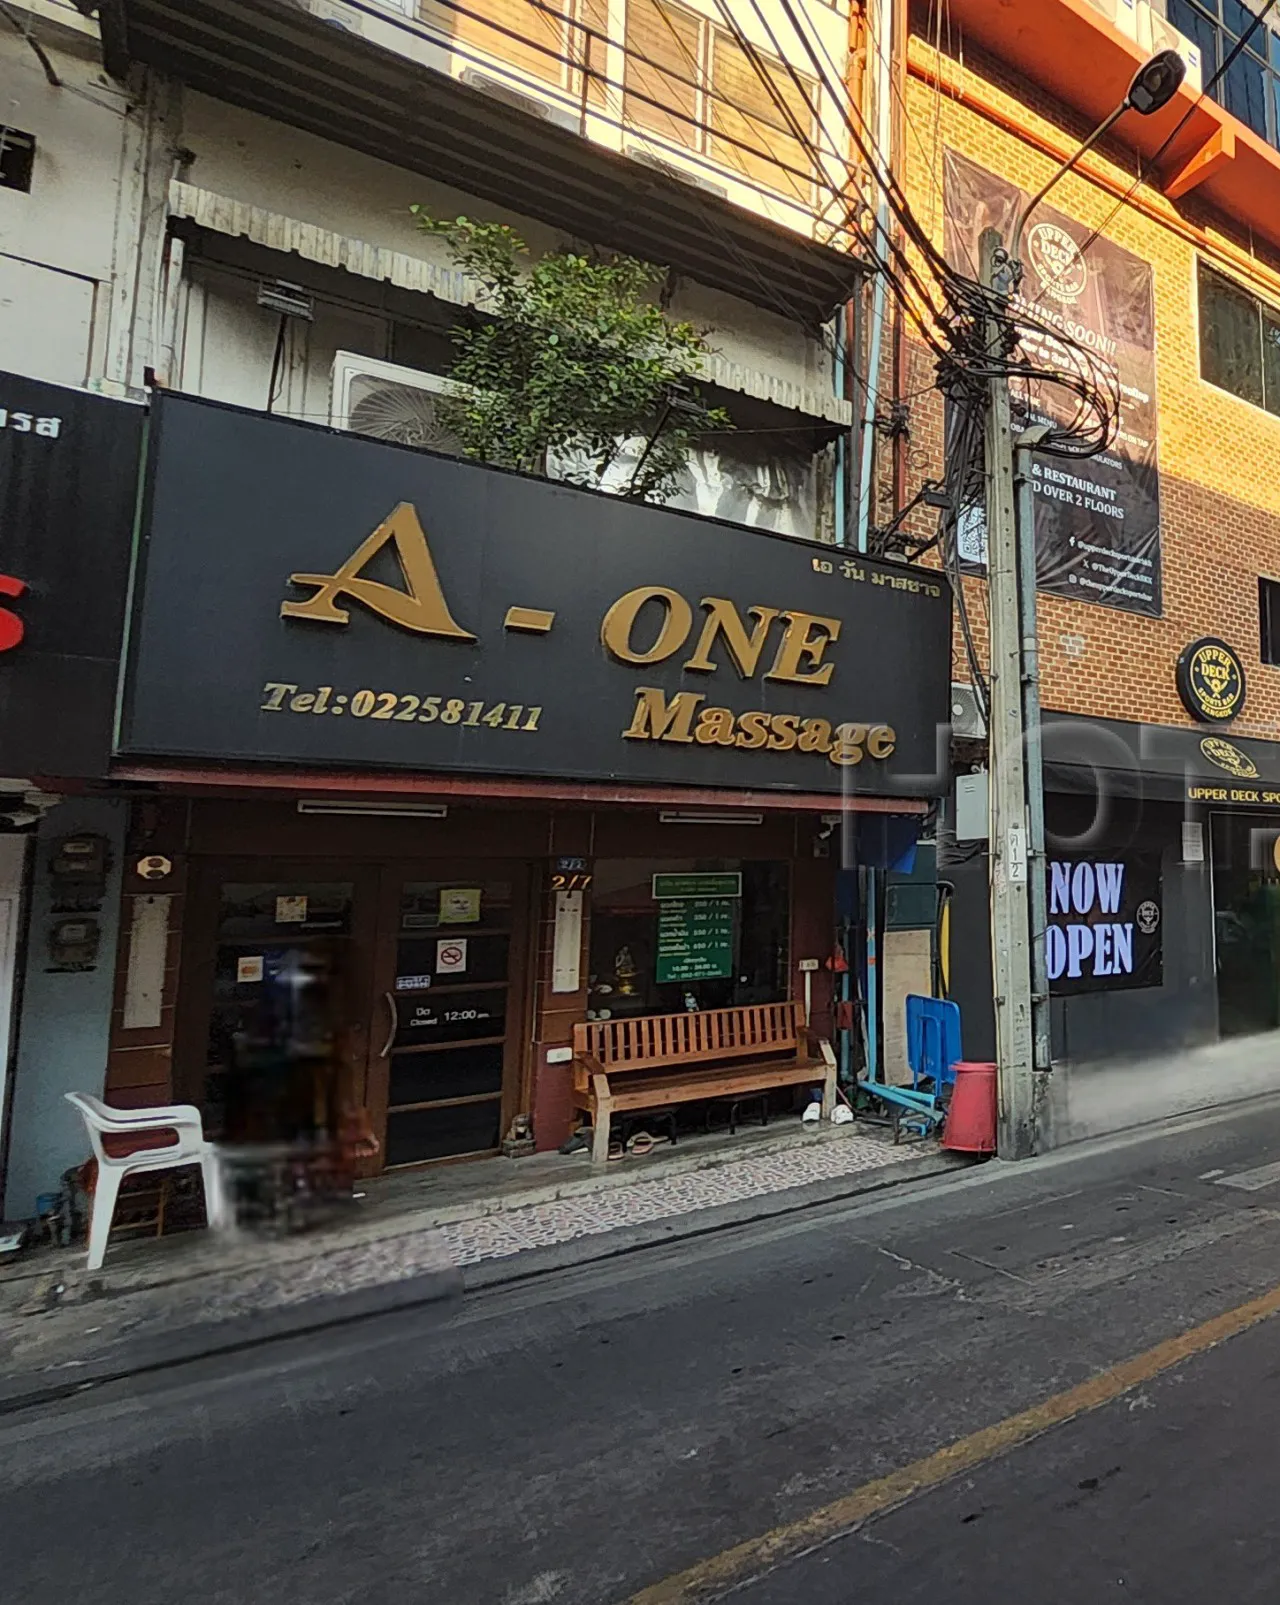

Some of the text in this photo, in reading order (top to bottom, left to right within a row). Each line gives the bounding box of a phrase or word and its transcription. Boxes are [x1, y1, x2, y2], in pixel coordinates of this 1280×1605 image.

[1032, 463, 1117, 501] & RESTAURANT
[1043, 483, 1074, 504] OVER
[1075, 493, 1083, 505] 2
[1084, 496, 1124, 519] FLOORS
[280, 501, 842, 685] A - ONE
[1198, 649, 1231, 666] UPPER
[1201, 663, 1230, 681] DECK
[260, 682, 543, 731] Tel:022581411
[1198, 687, 1235, 707] SPORTS BAR
[1201, 703, 1233, 718] BANGKOK
[622, 686, 897, 765] Massage
[1188, 787, 1227, 801] UPPER
[1231, 789, 1260, 802] DECK
[551, 874, 593, 890] 2/7
[1050, 861, 1124, 914] NOW
[1046, 923, 1133, 980] OPEN
[444, 1010, 476, 1021] 12:00
